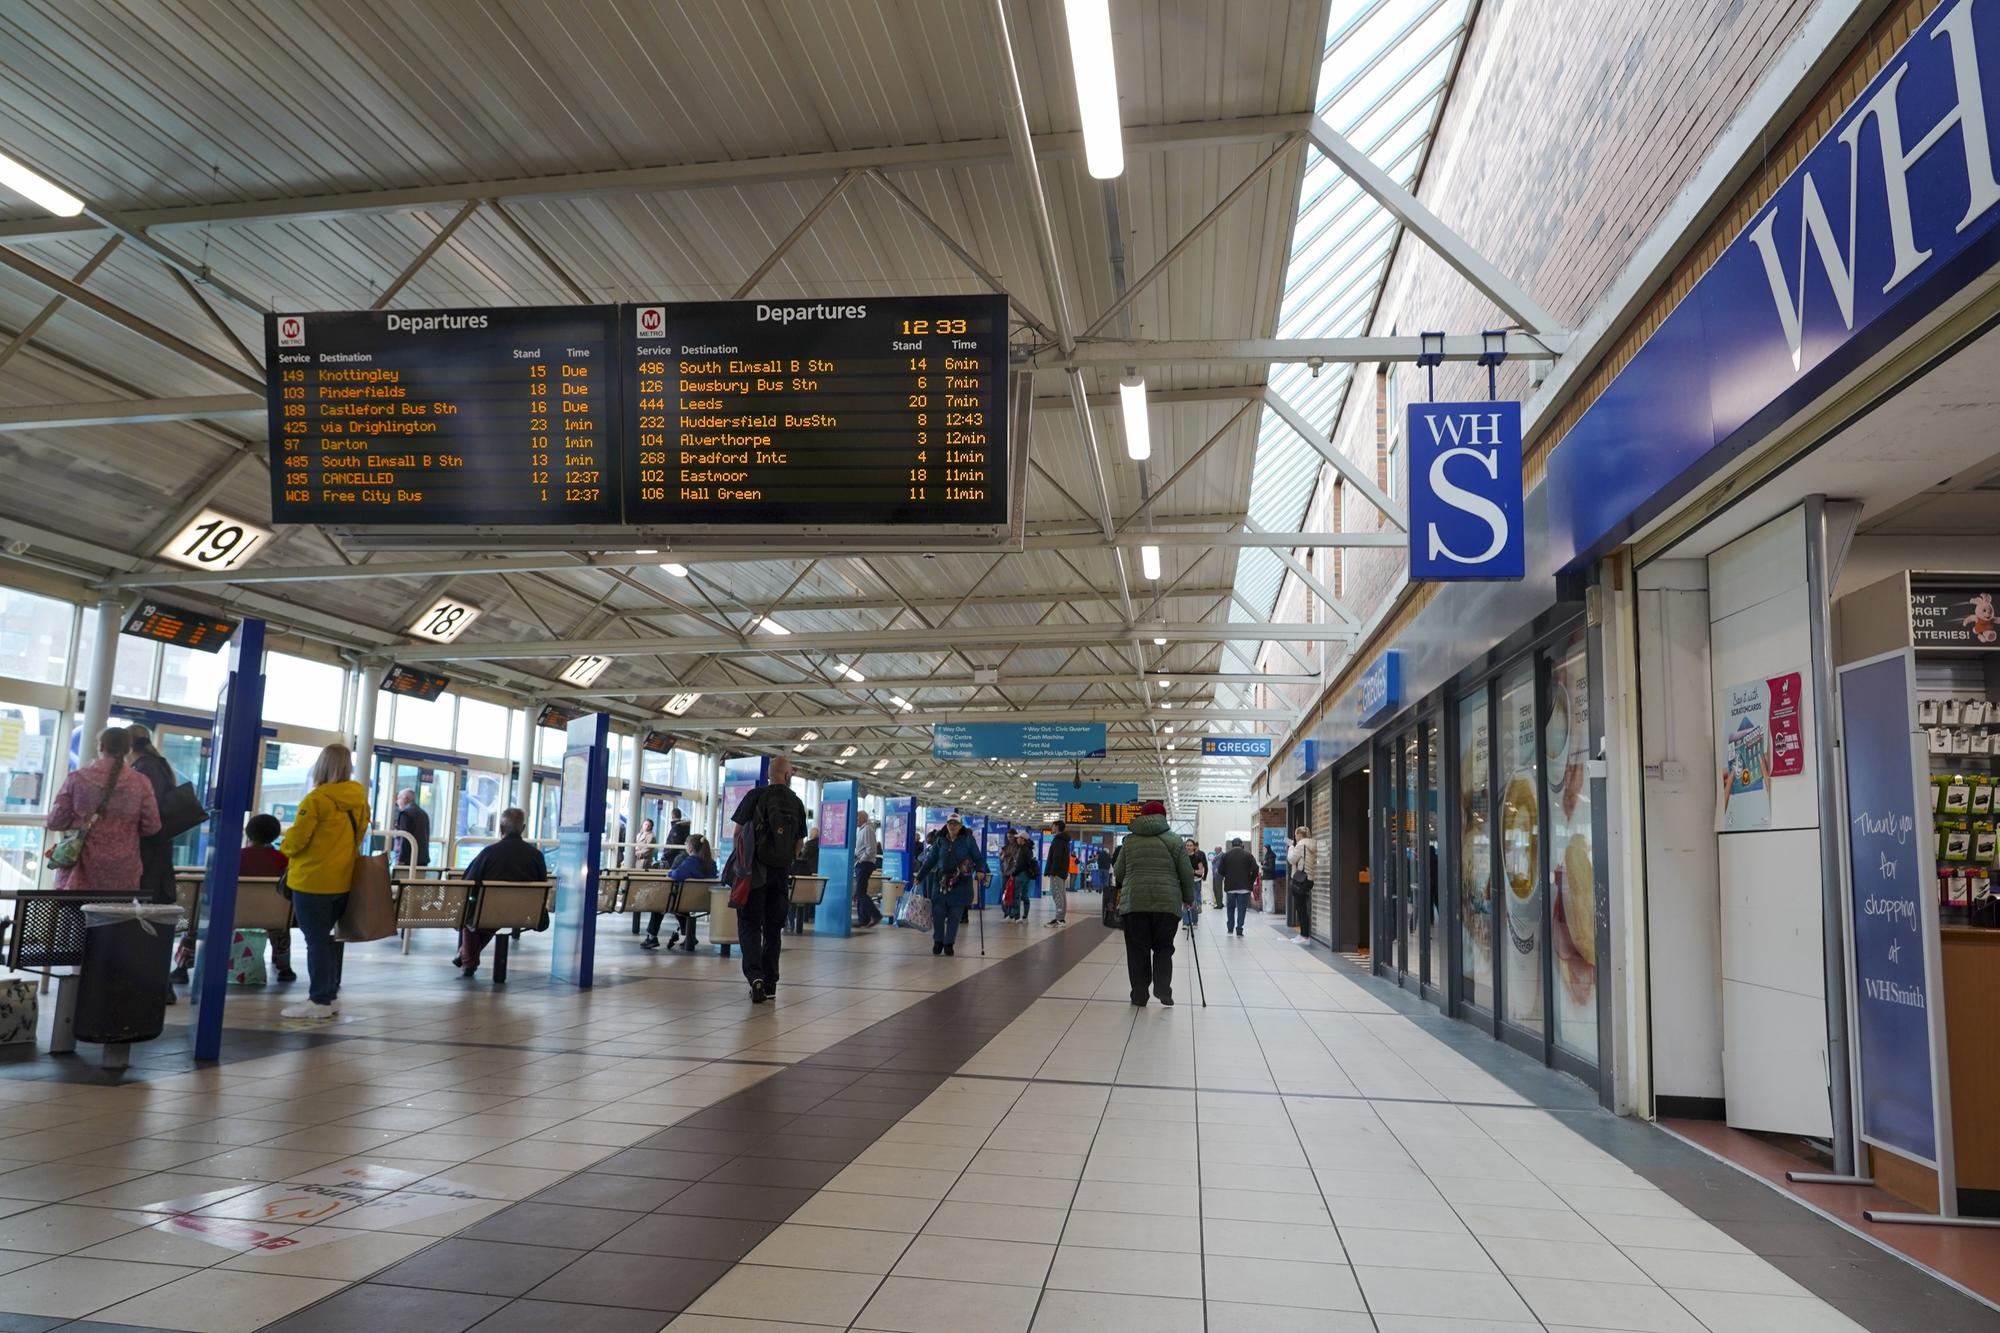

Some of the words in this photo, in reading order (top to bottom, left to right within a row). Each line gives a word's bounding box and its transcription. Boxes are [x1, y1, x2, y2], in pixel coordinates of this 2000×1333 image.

[1749, 0, 2000, 372] WH
[757, 304, 866, 324] Departures
[387, 314, 488, 334] Departures
[637, 346, 671, 355] Service
[681, 344, 738, 354] Destination
[892, 340, 922, 351] Stand
[952, 339, 977, 349] Time
[279, 353, 310, 363] Service
[320, 352, 372, 362] Destination
[513, 348, 540, 359] Stand
[567, 347, 590, 357] Time
[639, 362, 664, 374] 496
[680, 362, 721, 374] South
[730, 361, 782, 373] Elmsall
[791, 361, 799, 372] B
[808, 361, 833, 372] Stn
[910, 358, 927, 370] 14
[945, 358, 978, 370] 6min
[283, 370, 304, 382] 149
[319, 370, 399, 384] Knottingley
[530, 366, 546, 378] 15
[562, 366, 588, 377] Due
[283, 387, 305, 399] 103
[320, 386, 405, 398] Pinderfields
[530, 384, 547, 395] 18
[562, 384, 588, 395] Due
[640, 381, 662, 392] 126
[680, 380, 749, 394] Dewsbury
[758, 379, 783, 391] Bus
[792, 379, 817, 391] Stn
[918, 377, 927, 389] 6
[945, 377, 978, 388] 7min
[284, 405, 305, 416] 189
[320, 404, 394, 416] Castleford
[402, 404, 426, 415] Bus
[434, 403, 457, 415] Stn
[531, 402, 547, 413] 16
[563, 402, 588, 413] Due
[639, 398, 664, 410] 444
[680, 398, 722, 410] Leeds
[909, 396, 927, 407] 20
[945, 396, 978, 407] 7min
[283, 421, 307, 433] 425
[321, 421, 343, 432] via
[350, 420, 436, 435] Drighlington
[531, 419, 547, 431] 23
[565, 419, 593, 431] 1min
[640, 417, 664, 428] 232
[680, 416, 777, 428] Huddersfield
[785, 415, 836, 427] BusStn
[918, 414, 927, 426] 8
[946, 414, 983, 425] 12:43
[1424, 413, 1502, 446] WH
[284, 439, 300, 450] 97
[321, 438, 367, 450] Darton
[532, 437, 547, 449] 10
[565, 437, 593, 448] 1min
[641, 435, 663, 446] 104
[680, 434, 771, 448] Alverthorpe
[918, 433, 927, 444] 3
[946, 432, 986, 444] 12min
[285, 456, 308, 468] 485
[322, 456, 360, 468] South
[368, 456, 416, 467] Elmsall
[424, 456, 432, 467] B
[439, 455, 462, 467] Stn
[532, 455, 548, 466] 13
[566, 455, 593, 466] 1min
[640, 452, 665, 464] 268
[680, 452, 748, 464] Bradford
[757, 452, 787, 464] Intc
[918, 451, 927, 463] 4
[946, 451, 984, 463] 11min
[286, 473, 308, 485] 195
[323, 473, 394, 484] CANCELLED
[532, 472, 548, 484] 12
[566, 472, 599, 484] 12:37
[641, 471, 664, 482] 102
[681, 470, 748, 482] Eastmoor
[910, 469, 927, 481] 18
[946, 469, 984, 481] 11min
[286, 490, 310, 502] WCB
[323, 490, 355, 502] Free
[362, 490, 391, 504] City
[398, 490, 422, 501] Bus
[540, 490, 548, 501] 1
[566, 489, 599, 501] 12:37
[641, 488, 664, 500] 106
[681, 488, 709, 500] Hall
[718, 488, 761, 500] Green
[910, 488, 925, 499] 11
[946, 488, 984, 499] 11min
[1427, 447, 1508, 564] S
[183, 519, 244, 562] 19
[1910, 595, 1936, 604] ON'T
[142, 605, 157, 617] 19
[424, 603, 465, 636] 18
[1911, 618, 1934, 627] OUR
[1913, 630, 1970, 639] ATTERIES!
[570, 655, 602, 679] 17
[1731, 702, 1762, 717] SCRATCHCARDS
[1218, 743, 1265, 752] GREGGS
[1854, 811, 1897, 836] Thank
[1899, 816, 1912, 844] you
[1880, 851, 1897, 879] for
[1864, 894, 1916, 932] shopping
[1889, 944, 1900, 964] at
[1865, 978, 1925, 1008] WHSmith
